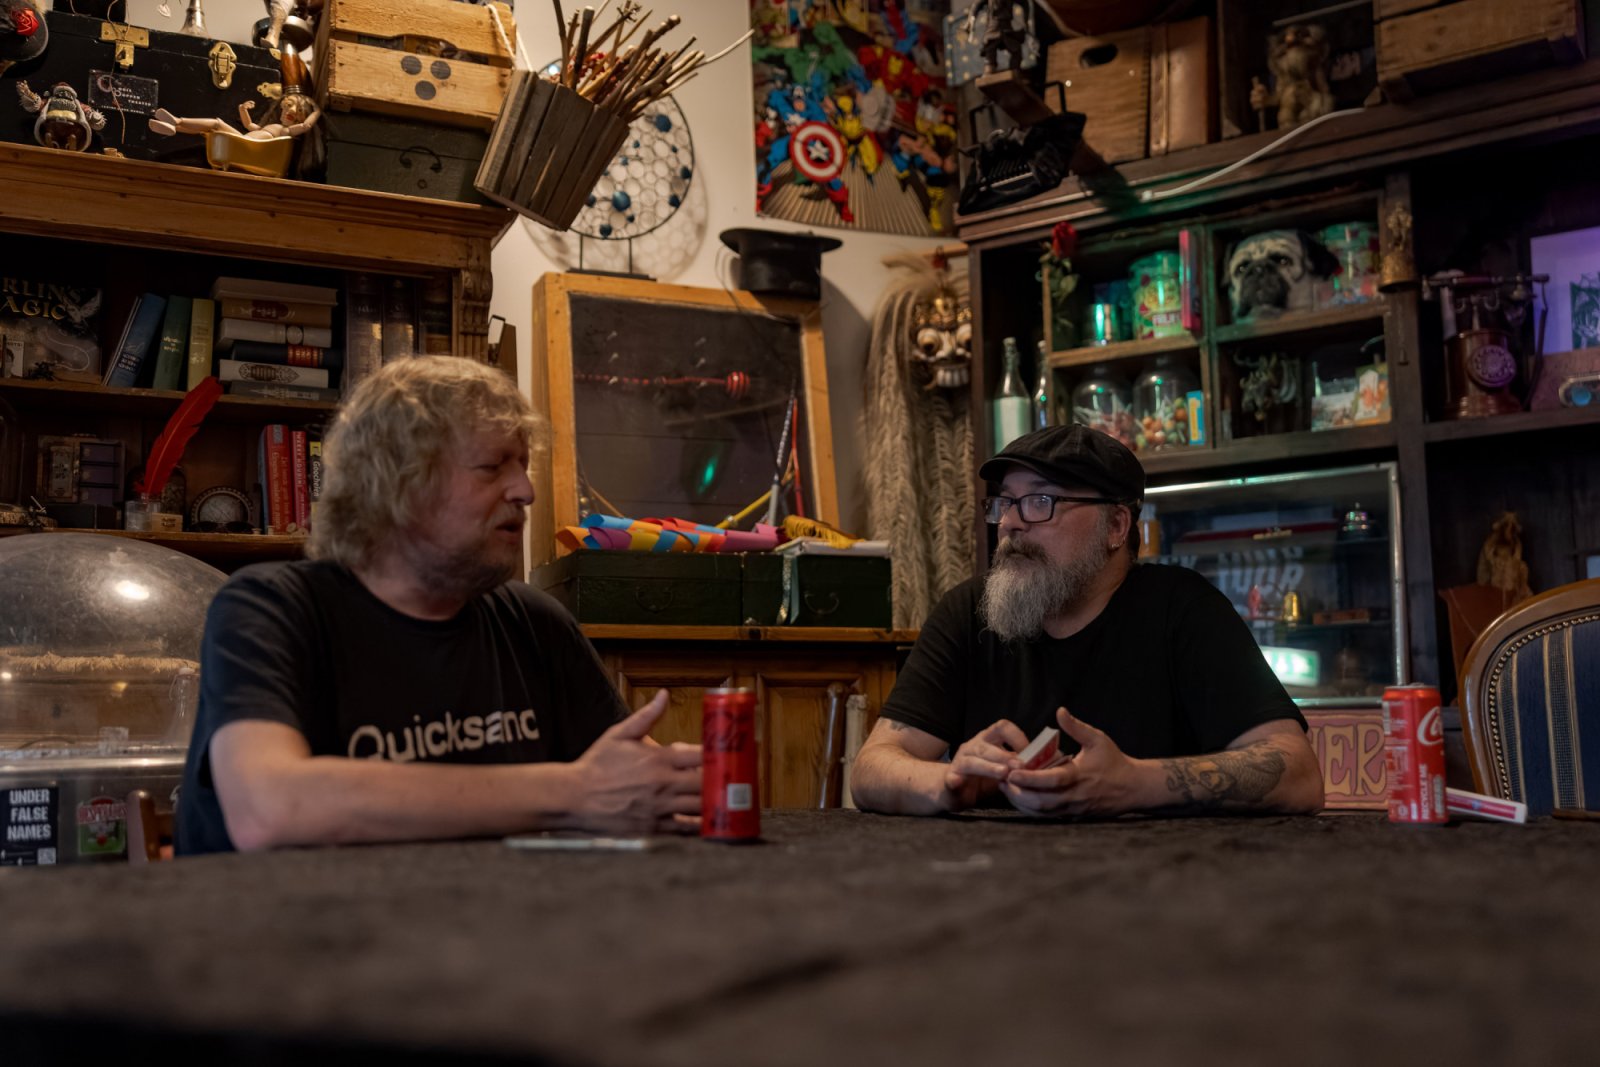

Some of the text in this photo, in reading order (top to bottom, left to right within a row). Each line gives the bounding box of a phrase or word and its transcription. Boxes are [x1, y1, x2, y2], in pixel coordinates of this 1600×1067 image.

[0, 296, 67, 320] AGIC
[9, 788, 50, 805] UNDER
[10, 805, 49, 822] FALSE
[6, 823, 52, 841] NAMES
